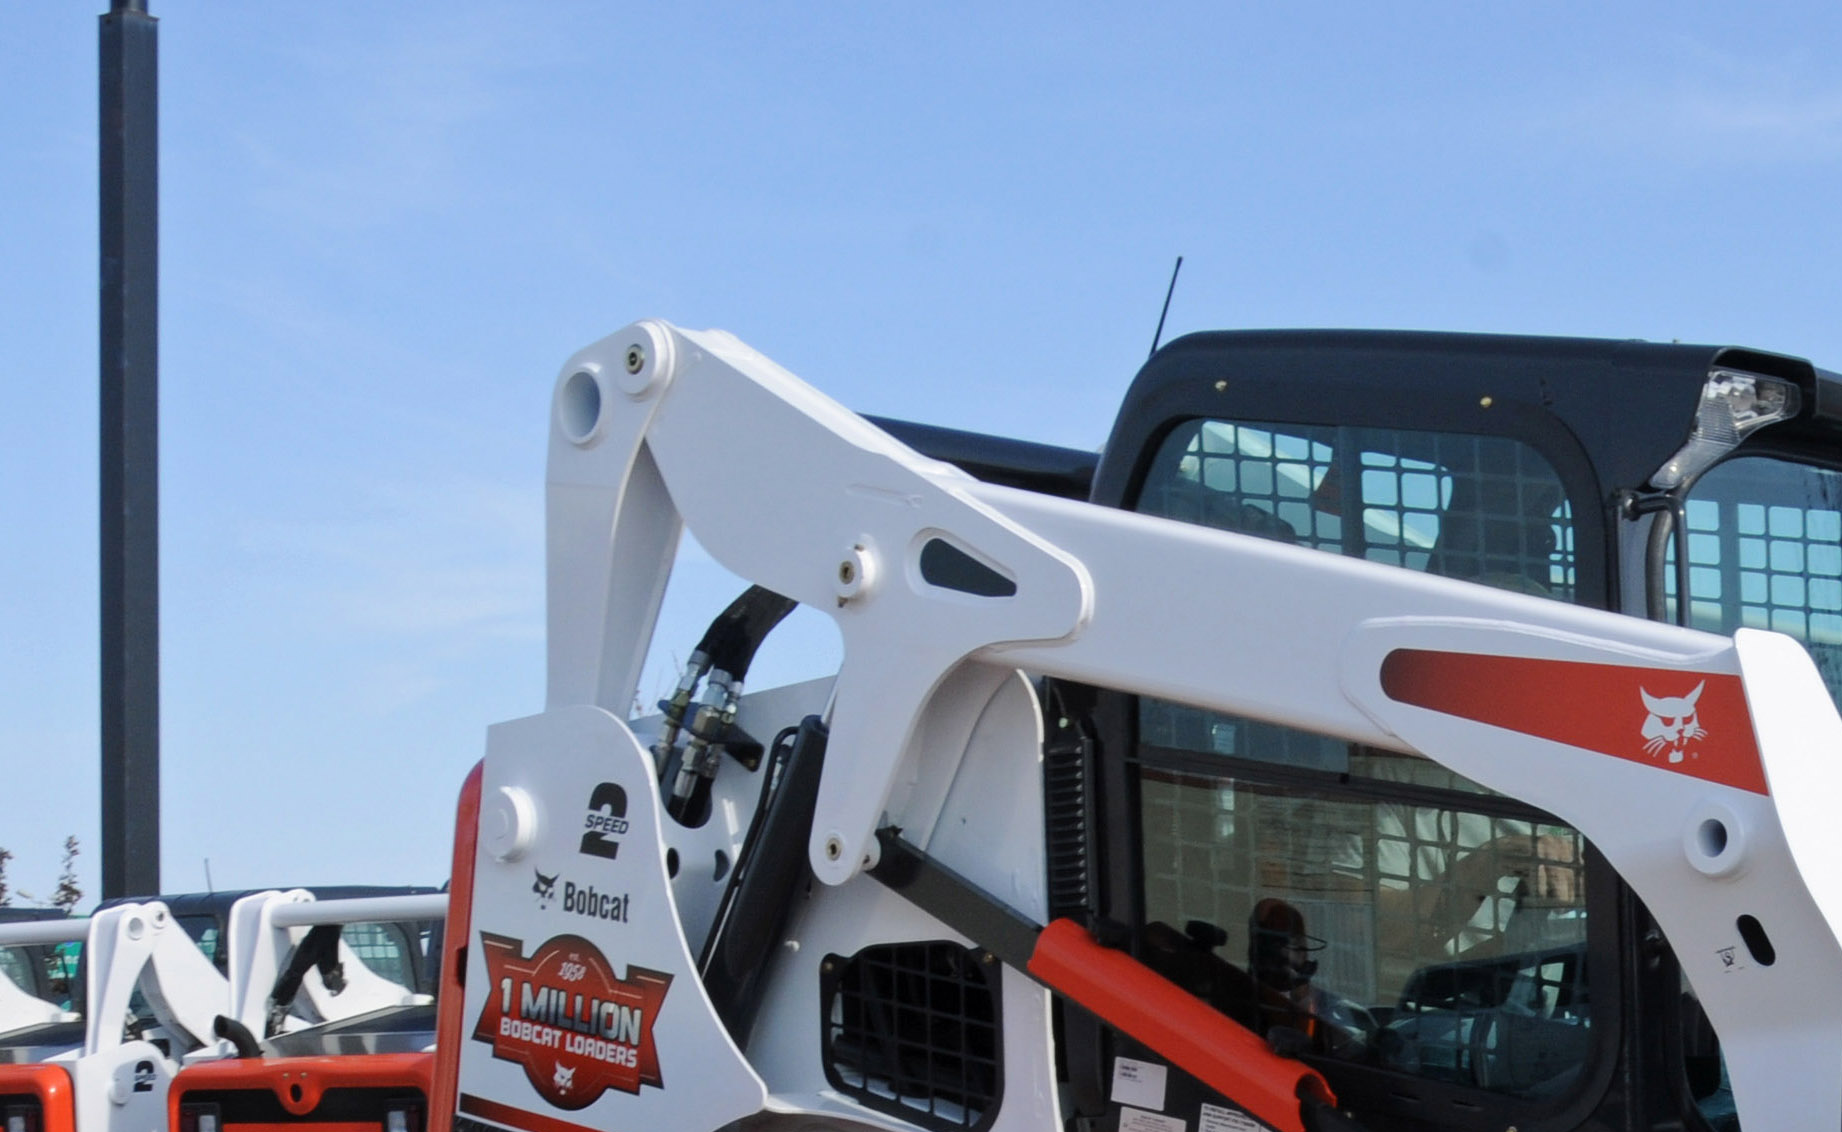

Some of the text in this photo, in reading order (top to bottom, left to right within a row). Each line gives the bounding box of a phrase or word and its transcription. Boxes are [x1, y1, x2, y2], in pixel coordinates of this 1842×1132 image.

[584, 813, 629, 835] SPEED
[563, 881, 629, 924] Bobcat
[501, 976, 642, 1047] 1 MILLION
[500, 1017, 638, 1069] BOBCAT LOADERS
[133, 1060, 155, 1092] 2
